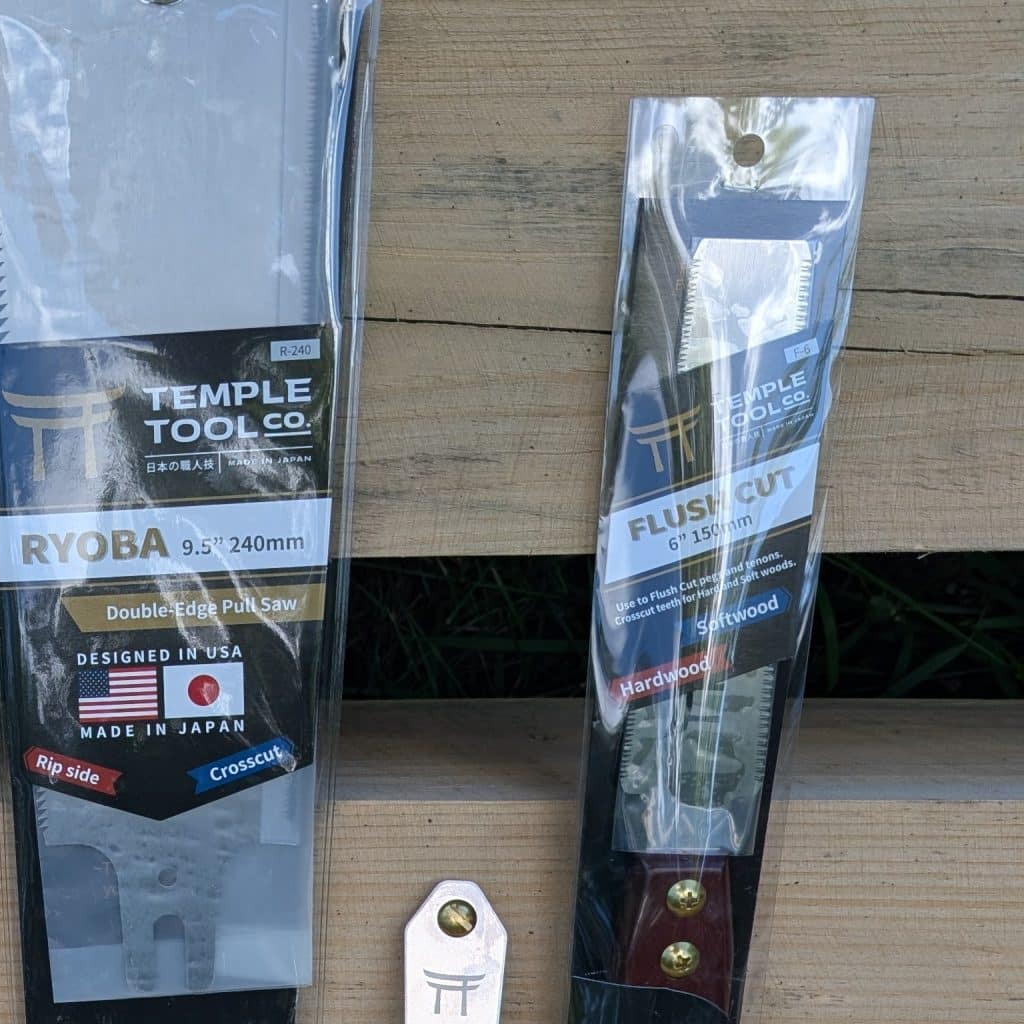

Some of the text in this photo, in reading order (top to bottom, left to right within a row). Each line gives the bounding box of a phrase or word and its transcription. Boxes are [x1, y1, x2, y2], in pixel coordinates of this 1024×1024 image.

[280, 344, 312, 357] R-240
[793, 346, 811, 360] F-6
[143, 377, 312, 411] TEMPLE
[711, 371, 807, 416] TEMPLE
[781, 391, 810, 407] CO.
[144, 411, 312, 444] TOOL CO.
[146, 458, 215, 473] 日本の職人技
[228, 455, 312, 467] MADE IN JAPAN
[735, 466, 795, 504] CUT
[21, 528, 304, 565] RYOBA 9.5” 240mm
[669, 533, 686, 551] 6”
[615, 601, 635, 613] Use
[637, 596, 648, 605] to
[649, 584, 678, 601] Flush
[679, 579, 697, 591] Cut
[745, 551, 783, 569] tenons.
[615, 609, 655, 626] Crosscut
[656, 599, 681, 613] teeth
[682, 594, 696, 605] for
[697, 583, 720, 599] Hard
[740, 571, 759, 584] Soft
[760, 558, 797, 577] woods.
[106, 597, 297, 621] Double-Edge Pull Saw
[696, 594, 779, 635] Softwood
[77, 645, 242, 665] DESIGNED IN USA
[620, 656, 711, 697] Hardwood
[80, 719, 245, 740] MADE IN JAPAN
[36, 754, 100, 786] Rip side
[210, 745, 283, 783] Crosscut
